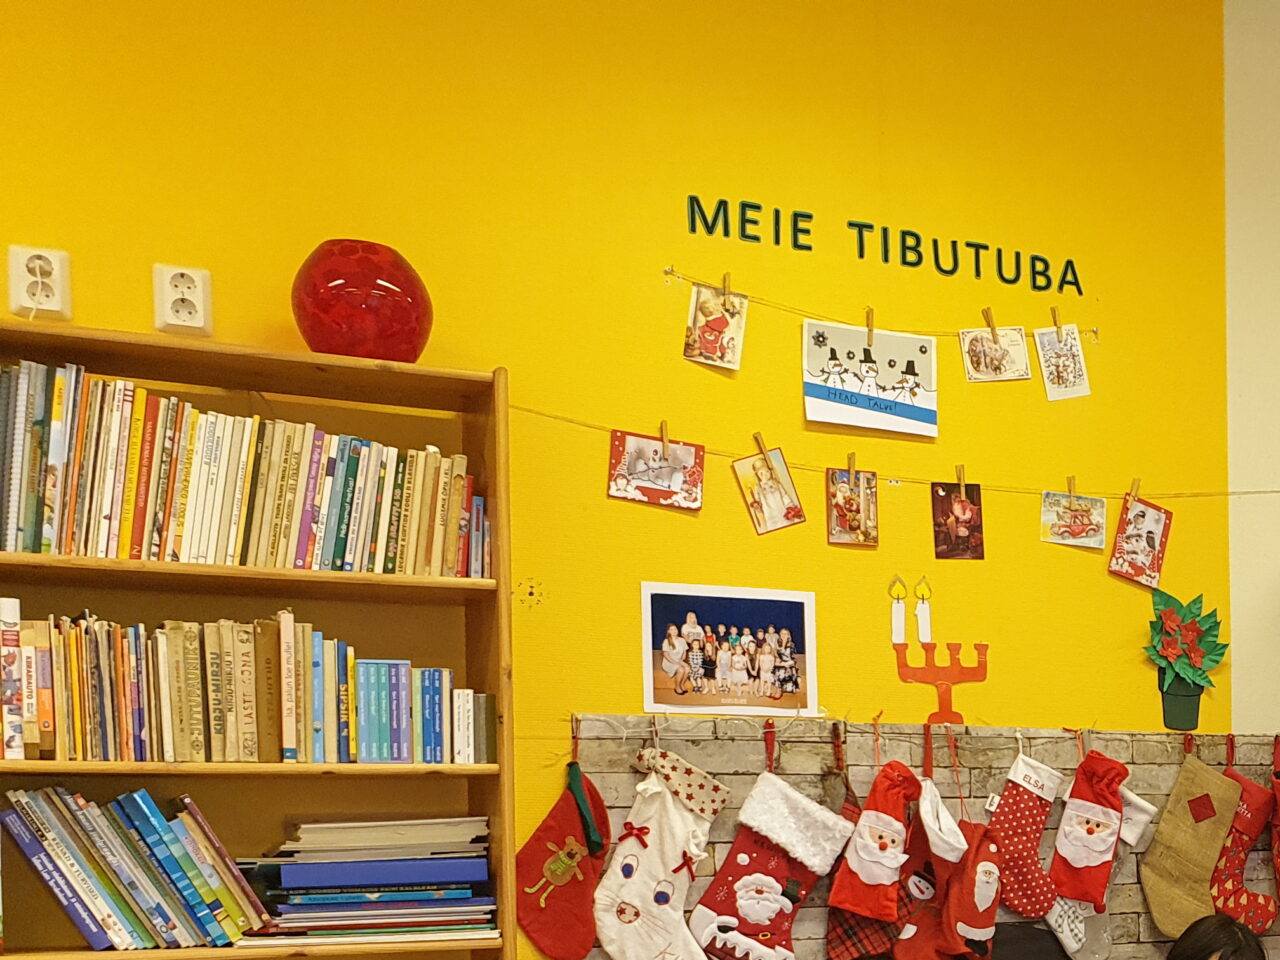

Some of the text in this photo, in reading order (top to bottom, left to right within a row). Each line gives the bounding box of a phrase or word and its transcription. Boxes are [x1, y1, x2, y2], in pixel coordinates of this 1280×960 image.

[687, 195, 1083, 296] MEIE TIBUTUBA
[828, 389, 858, 405] HEAD
[210, 652, 224, 734] KIRJU-MIRJU
[340, 684, 348, 722] SIPSIK
[1023, 774, 1045, 791] ELSA
